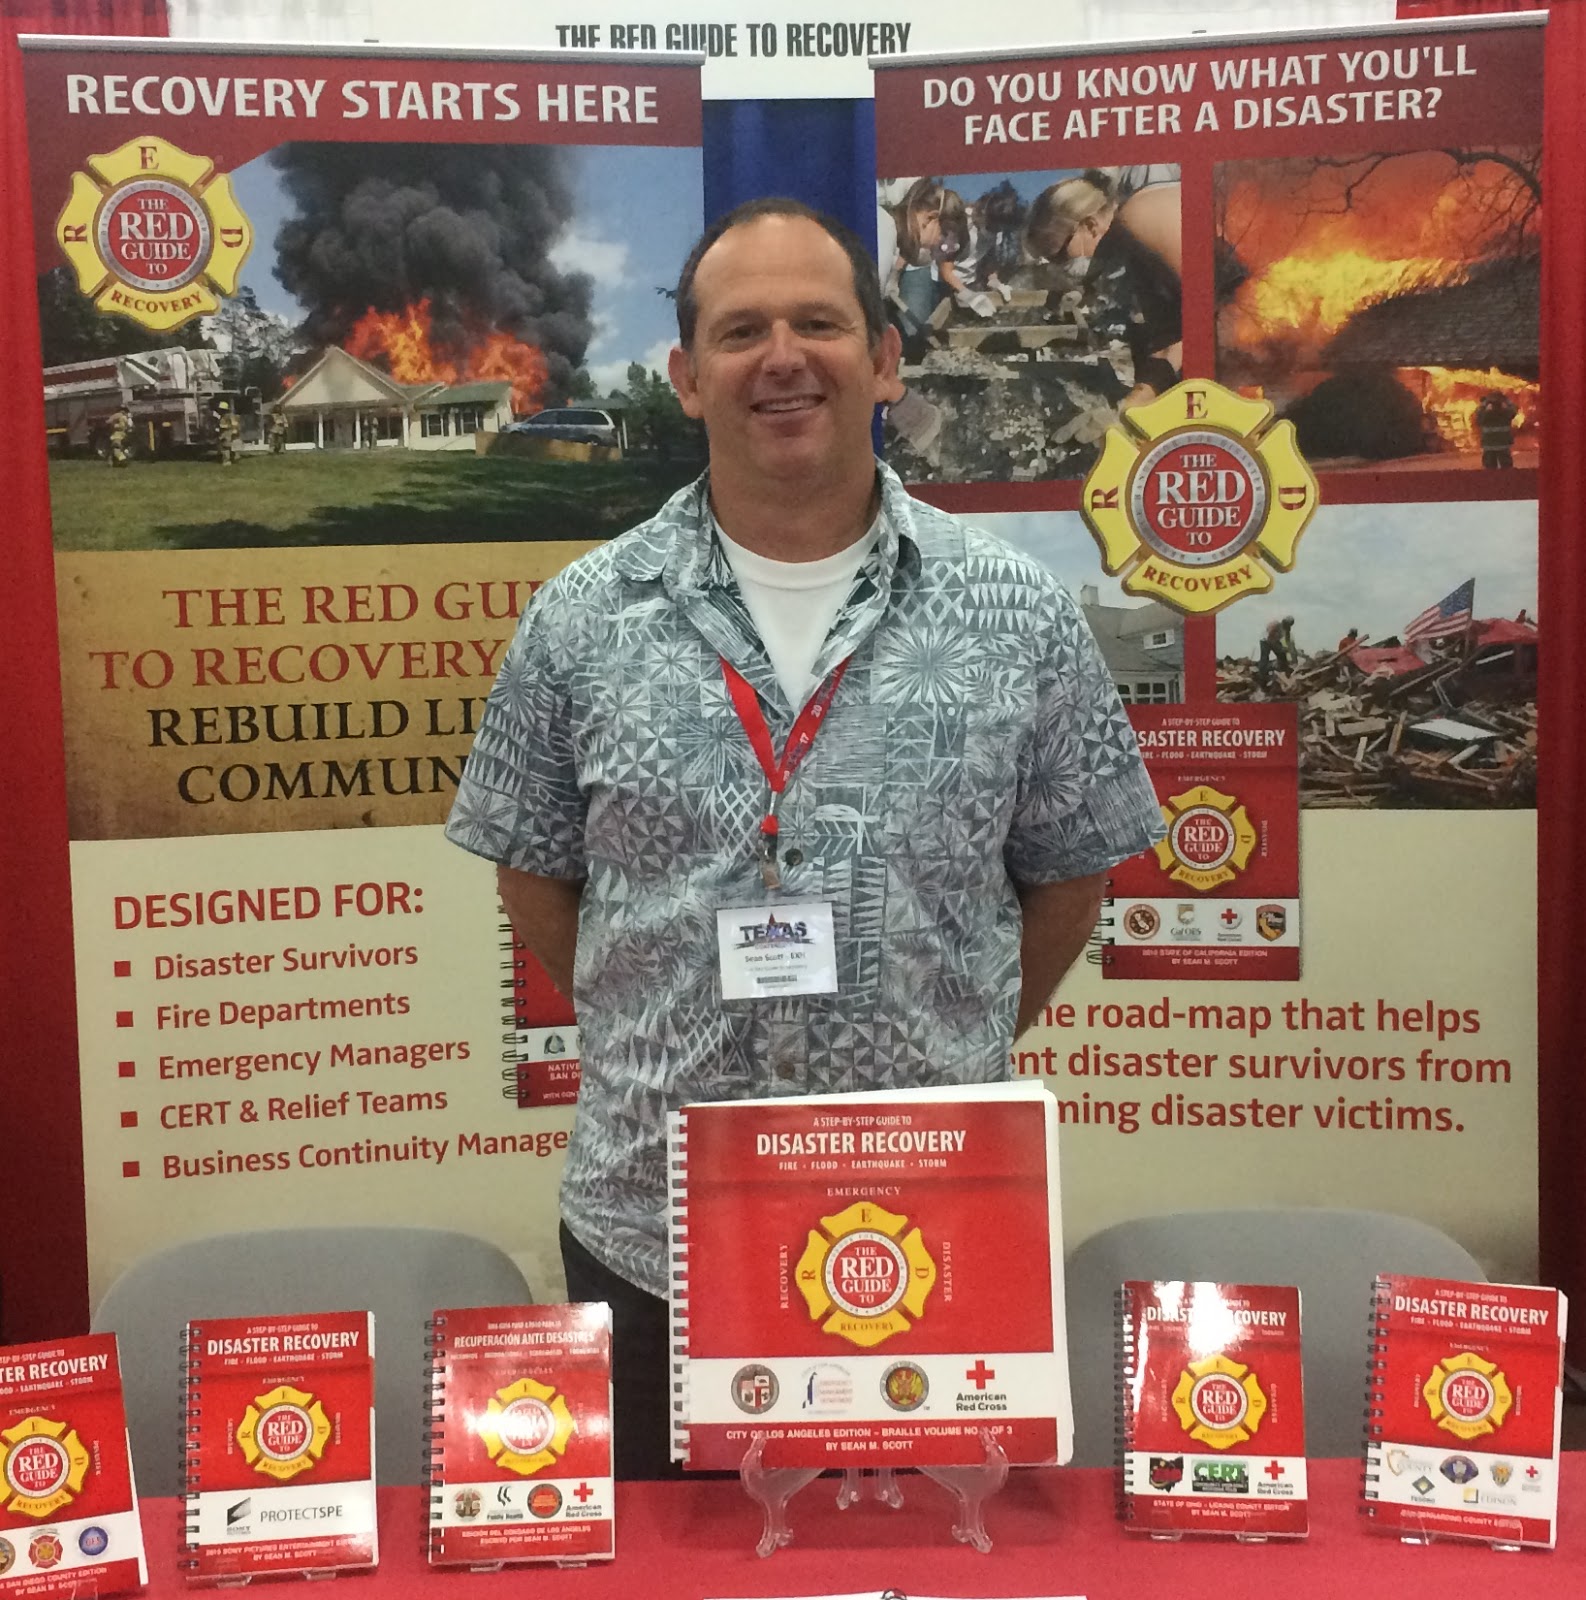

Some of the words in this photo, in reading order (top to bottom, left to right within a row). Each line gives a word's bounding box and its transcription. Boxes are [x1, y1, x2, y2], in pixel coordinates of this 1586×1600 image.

[555, 24, 600, 49] THE
[610, 24, 656, 49] RED
[666, 23, 737, 57] GUIDE
[746, 23, 775, 57] TO
[786, 22, 911, 57] RECOVERY
[923, 77, 975, 108] DO
[987, 69, 1062, 103] YOU
[1077, 62, 1197, 99] KNOW
[1210, 53, 1328, 91] WHAT
[1339, 44, 1477, 82] YOU'LL
[66, 74, 326, 119] RECOVERY
[341, 79, 521, 122] STARTS
[537, 84, 659, 124] HERE
[964, 111, 1052, 145] FACE
[1063, 104, 1182, 139] AFTER
[1193, 101, 1220, 132] A
[1234, 87, 1443, 130] DISASTER?
[138, 145, 160, 170] E
[137, 198, 168, 211] THE
[63, 223, 88, 244] R
[119, 211, 194, 241] RED
[220, 226, 243, 248] D
[121, 242, 191, 260] GUIDE
[146, 262, 167, 275] TO
[111, 289, 203, 314] RECOVERY
[1184, 390, 1208, 420] E
[1180, 453, 1217, 468] THE
[1155, 469, 1246, 506] RED
[1278, 484, 1307, 511] D
[1091, 487, 1119, 513] R
[1157, 506, 1241, 529] GUIDE
[1186, 531, 1212, 546] TO
[1142, 565, 1253, 592] RECOVERY
[161, 587, 286, 629] THE
[301, 583, 419, 625] RED
[89, 649, 174, 690] TO
[191, 638, 507, 687] RECOVERY
[147, 699, 409, 747] REBUILD
[424, 697, 489, 737] LI
[1136, 730, 1197, 747] SASTER
[1202, 729, 1286, 747] RECOVERY
[1184, 826, 1225, 842] RED
[1184, 842, 1222, 853] GUIDE
[114, 885, 321, 930] DESIGNED
[334, 881, 424, 918] FOR:
[740, 920, 807, 941] TEXAS
[155, 952, 275, 980] Disaster
[283, 943, 418, 973] Survivors
[156, 1005, 210, 1030] Fire
[220, 991, 410, 1030] Departments
[1087, 997, 1271, 1037] road-map
[1282, 1000, 1365, 1032] that
[1377, 999, 1480, 1041] helps
[159, 1046, 321, 1080] Emergency
[330, 1038, 471, 1069] Managers
[1010, 1047, 1057, 1075] nt
[1068, 1044, 1218, 1078] disaster
[1229, 1051, 1406, 1081] survivors
[1416, 1049, 1512, 1083] from
[160, 1100, 231, 1129] CERT
[240, 1099, 259, 1122] &
[268, 1092, 350, 1121] Relief
[356, 1088, 448, 1115] Teams
[1151, 1094, 1304, 1129] disaster
[1315, 1097, 1465, 1132] victims.
[820, 1116, 875, 1126] STEP-BY-STEP
[875, 1116, 900, 1126] GUIDE
[901, 1115, 912, 1125] TO
[757, 1132, 855, 1155] DISASTER
[861, 1130, 967, 1153] RECOVERY
[163, 1149, 290, 1179] Business
[298, 1135, 449, 1170] Continuity
[457, 1130, 573, 1158] Manage
[779, 1161, 797, 1170] FIRE
[811, 1161, 838, 1169] FLOOD
[851, 1160, 905, 1169] EARTHQUAKE
[918, 1158, 947, 1168] STORM
[827, 1186, 901, 1196] EMERGENCY
[861, 1208, 872, 1223] E
[855, 1247, 877, 1255] THE
[780, 1243, 789, 1309] RECOVERY
[840, 1256, 894, 1279] RED
[942, 1241, 952, 1302] DISASTER
[842, 1278, 892, 1294] GUIDE
[859, 1294, 874, 1304] TO
[1395, 1295, 1466, 1318] DISASTER
[1470, 1303, 1549, 1325] RECOVERY
[840, 1322, 895, 1332] RECOVERY
[207, 1337, 280, 1355] DISASTER
[283, 1331, 359, 1352] RECOVERY
[454, 1333, 520, 1348] RECUPERACIÓN
[521, 1332, 544, 1344] ANTE
[29, 1354, 108, 1379] RECOVERY
[956, 1392, 1006, 1401] American
[1202, 1389, 1238, 1405] RED
[1452, 1384, 1486, 1400] RED
[956, 1402, 975, 1411] Red
[977, 1402, 1007, 1411] Cross
[1203, 1404, 1236, 1415] GUIDE
[267, 1420, 303, 1436] RED
[726, 1430, 747, 1439] CITY
[766, 1430, 784, 1439] LOS
[787, 1429, 831, 1438] ANGELES
[833, 1428, 871, 1437] EDITION
[881, 1428, 921, 1437] BRAILLE
[924, 1427, 962, 1436] VOLUME
[267, 1435, 303, 1446] GUIDE
[841, 1441, 867, 1450] SEAN
[882, 1440, 913, 1450] SCOTT
[19, 1453, 58, 1472] RED
[1194, 1463, 1246, 1481] CERT
[20, 1468, 58, 1482] GUIDE
[260, 1505, 343, 1522] PROTECTSPE
